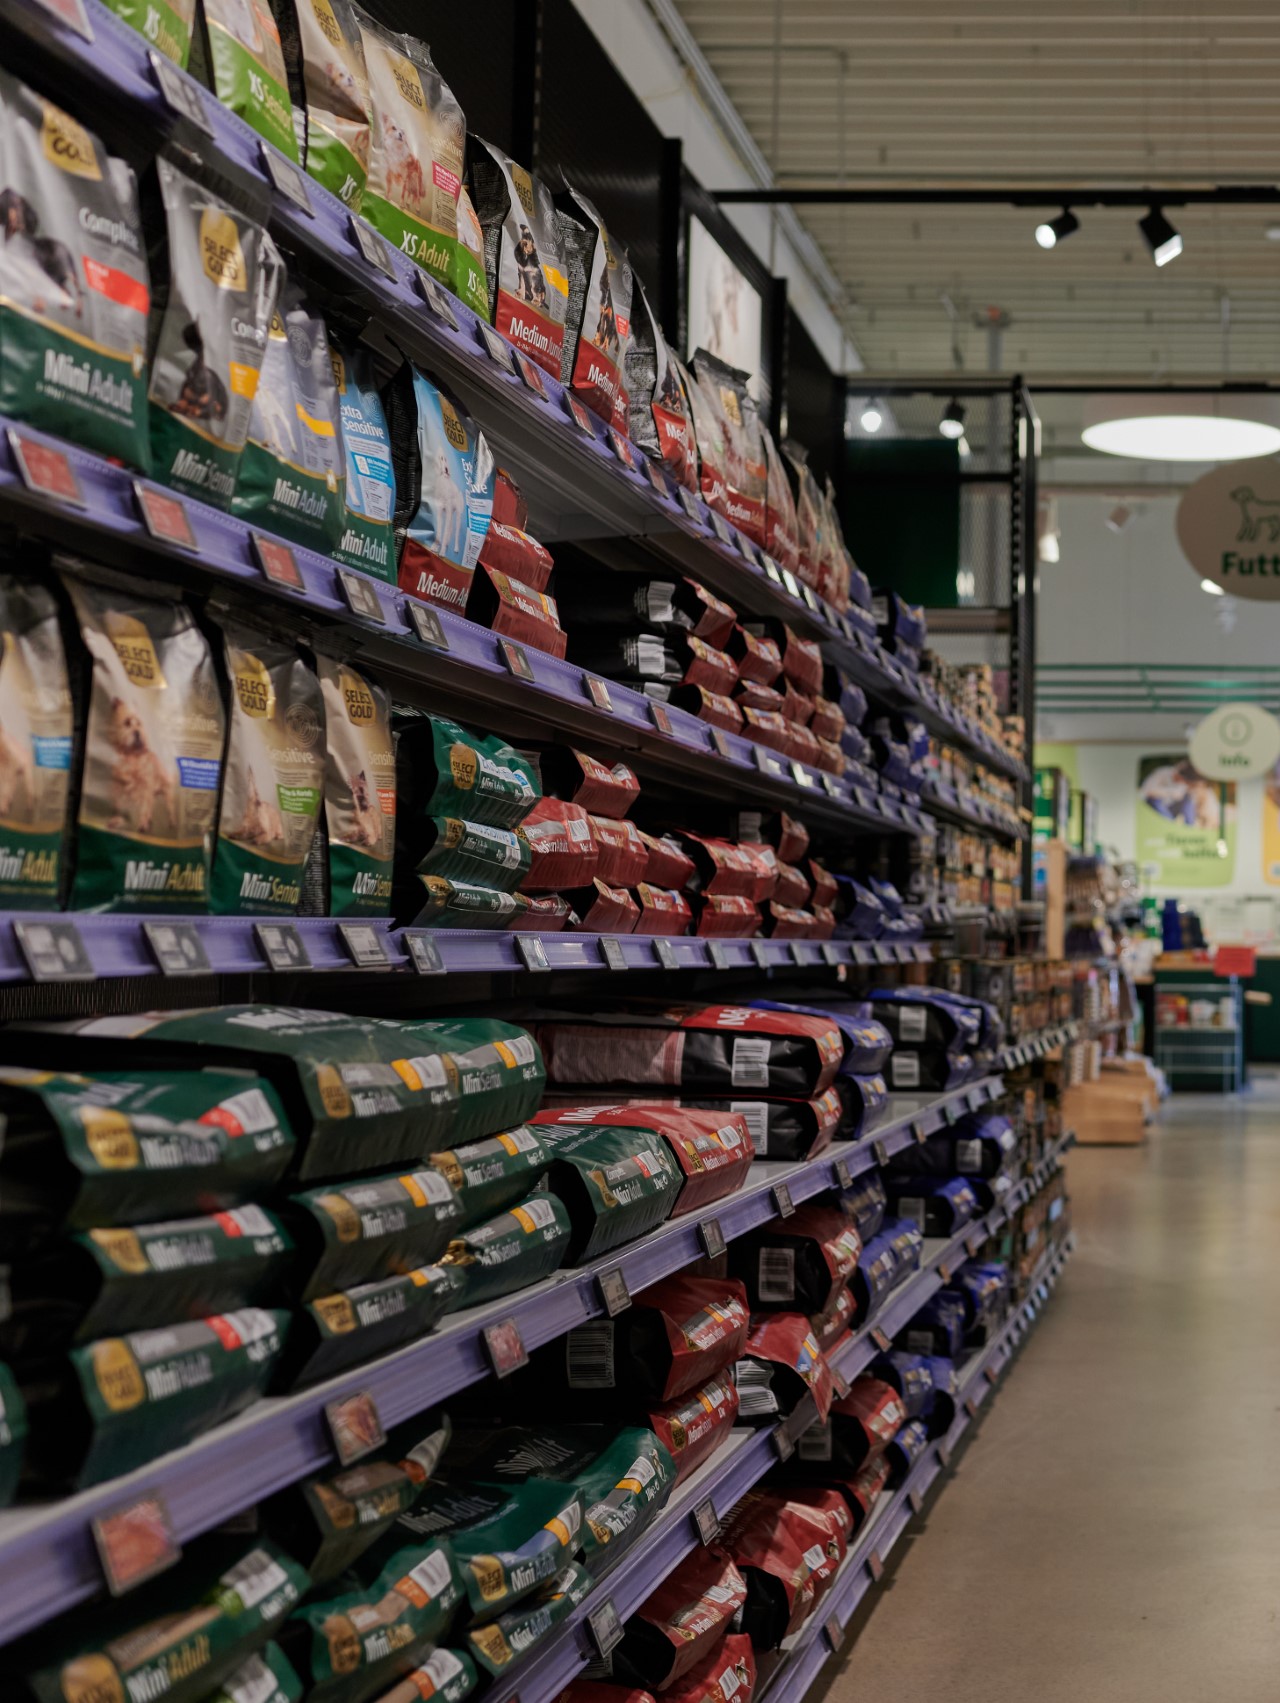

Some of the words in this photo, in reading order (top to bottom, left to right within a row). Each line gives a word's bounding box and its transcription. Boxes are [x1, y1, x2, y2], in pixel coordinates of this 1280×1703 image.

[339, 174, 357, 200] XS
[515, 181, 531, 199] SELECT
[400, 230, 419, 256] XS
[416, 240, 450, 273] Adult
[467, 267, 477, 292] XS
[510, 317, 548, 351] Medium
[44, 350, 91, 394] Mini
[343, 418, 384, 439] Sensitive
[443, 414, 464, 433] SELECT
[450, 428, 464, 445] GOLD
[171, 449, 209, 482] Mini
[204, 462, 236, 496] Senio
[273, 478, 301, 508] Mini
[300, 490, 328, 519] Adult
[341, 529, 364, 555] Mini
[362, 537, 388, 565] Adult
[417, 572, 459, 603] Medium
[236, 678, 267, 695] SELECT
[345, 690, 372, 705] SELECT
[240, 694, 266, 711] GOLD
[350, 703, 372, 718] GOLD
[368, 751, 395, 765] Sensiti
[453, 761, 474, 774] SELECT
[125, 860, 169, 890] Mini
[167, 863, 205, 890] Adult
[352, 872, 379, 895] Mini
[240, 872, 274, 900] Mini
[270, 877, 300, 905] Senio
[463, 1072, 481, 1094] Mini
[612, 1184, 631, 1206] Mini
[510, 1564, 536, 1592] Mini
[535, 1550, 557, 1580] Adult
[509, 1622, 533, 1650] Mini
[531, 1608, 552, 1638] Adult
